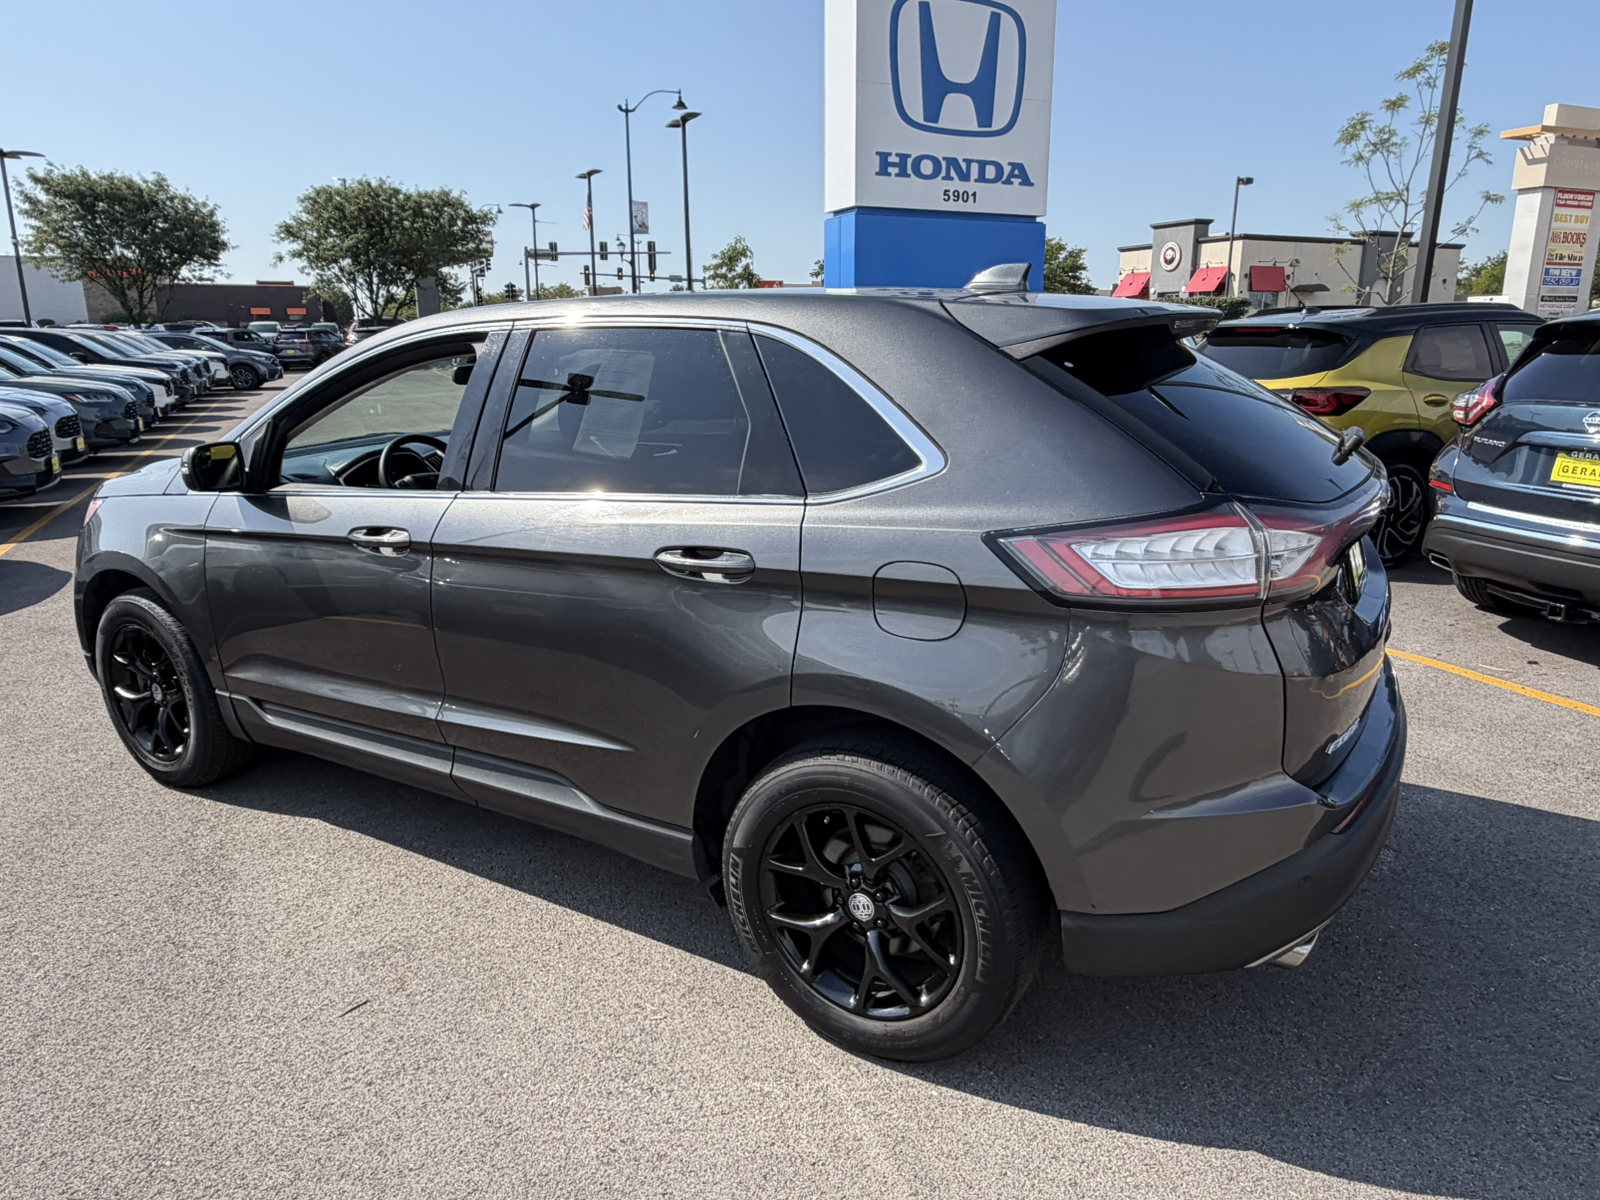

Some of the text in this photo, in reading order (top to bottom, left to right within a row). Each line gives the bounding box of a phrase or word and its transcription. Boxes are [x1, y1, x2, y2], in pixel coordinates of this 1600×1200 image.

[875, 151, 1035, 187] HONDA
[942, 189, 977, 204] 5901
[1554, 213, 1590, 224] BEST BUY
[1562, 231, 1587, 247] BOOKS
